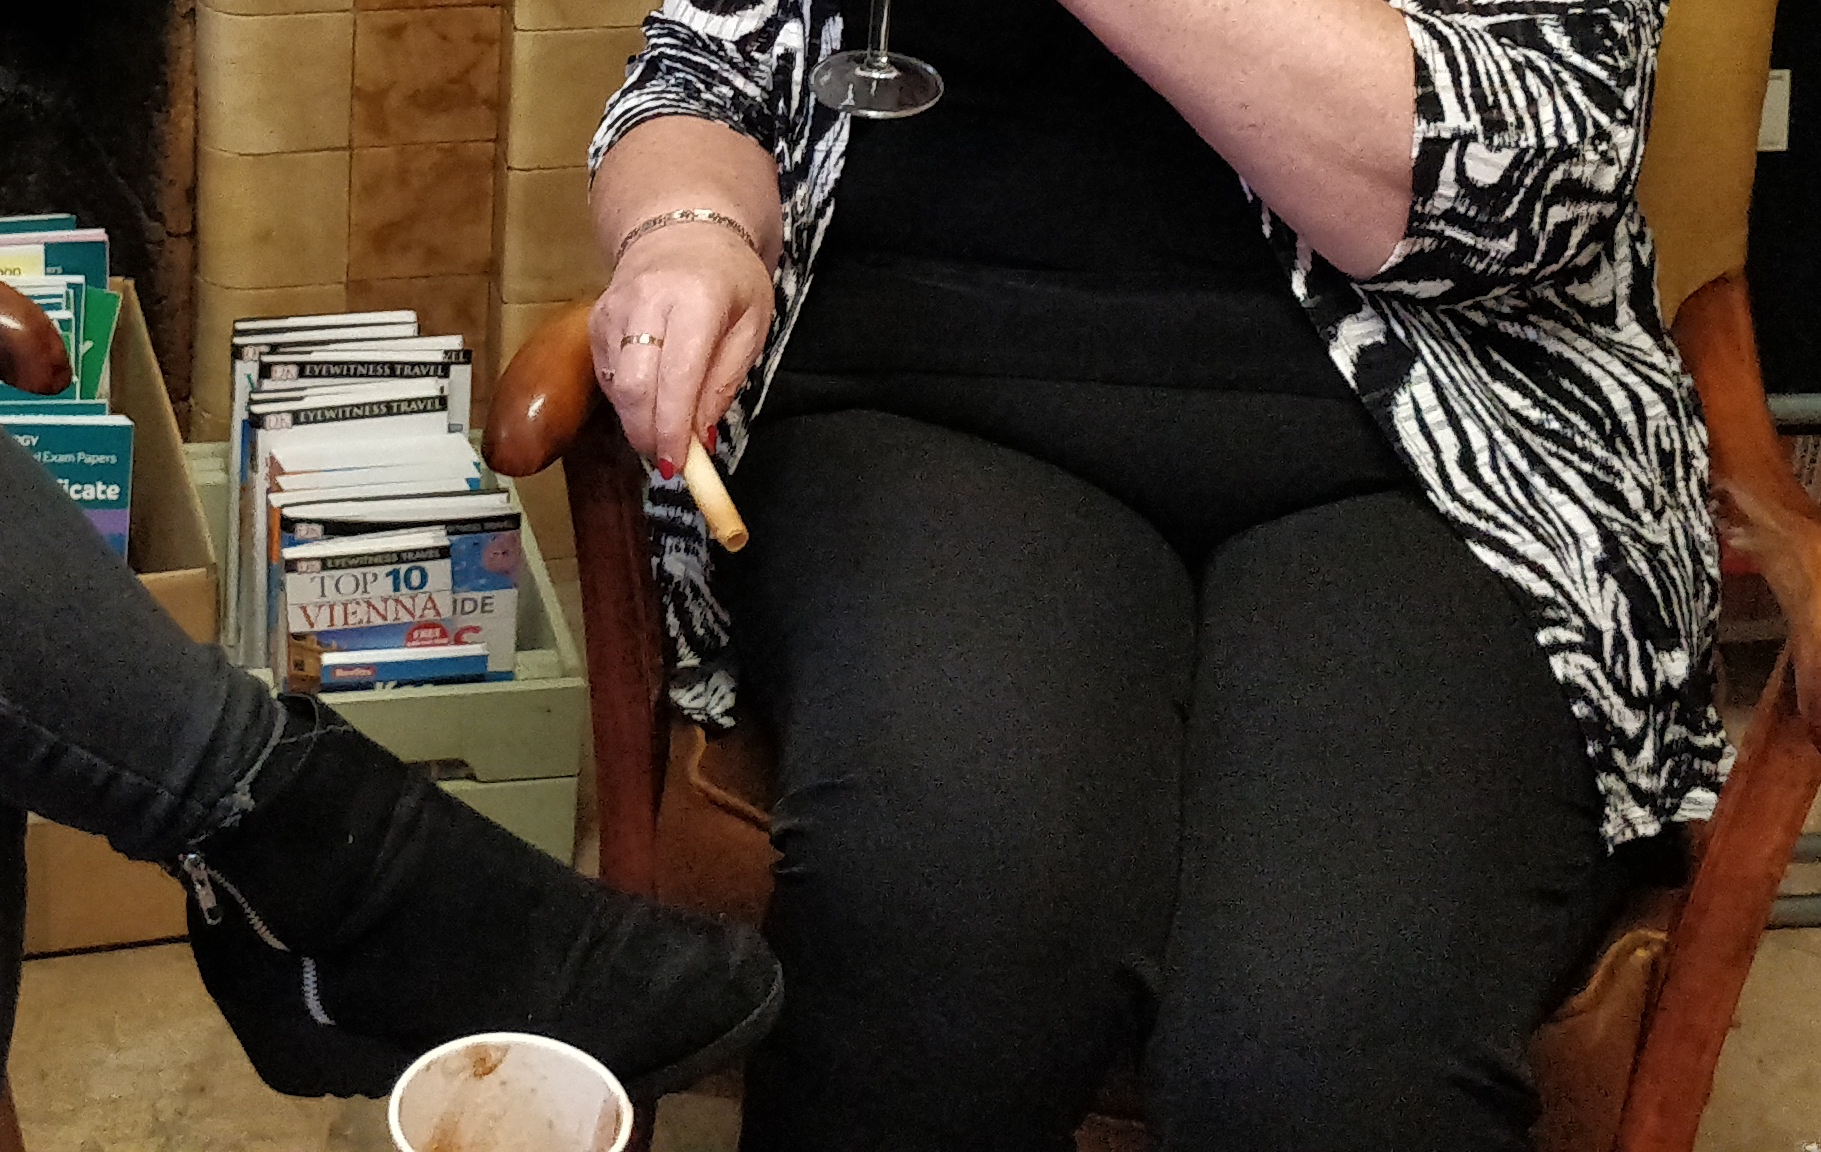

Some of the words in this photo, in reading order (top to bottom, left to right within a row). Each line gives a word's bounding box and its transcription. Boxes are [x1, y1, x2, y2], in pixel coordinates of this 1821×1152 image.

[304, 363, 391, 378] EYEWITNESS
[395, 364, 445, 378] TRAVEL
[298, 399, 387, 423] EYEWITNESS
[391, 398, 444, 415] TRAVEL
[43, 450, 76, 464] Exam
[76, 451, 118, 466] Papers
[400, 548, 442, 563] TRAVEL
[310, 571, 379, 598] TOP
[385, 565, 429, 593] 10
[299, 593, 443, 629] VIENNA
